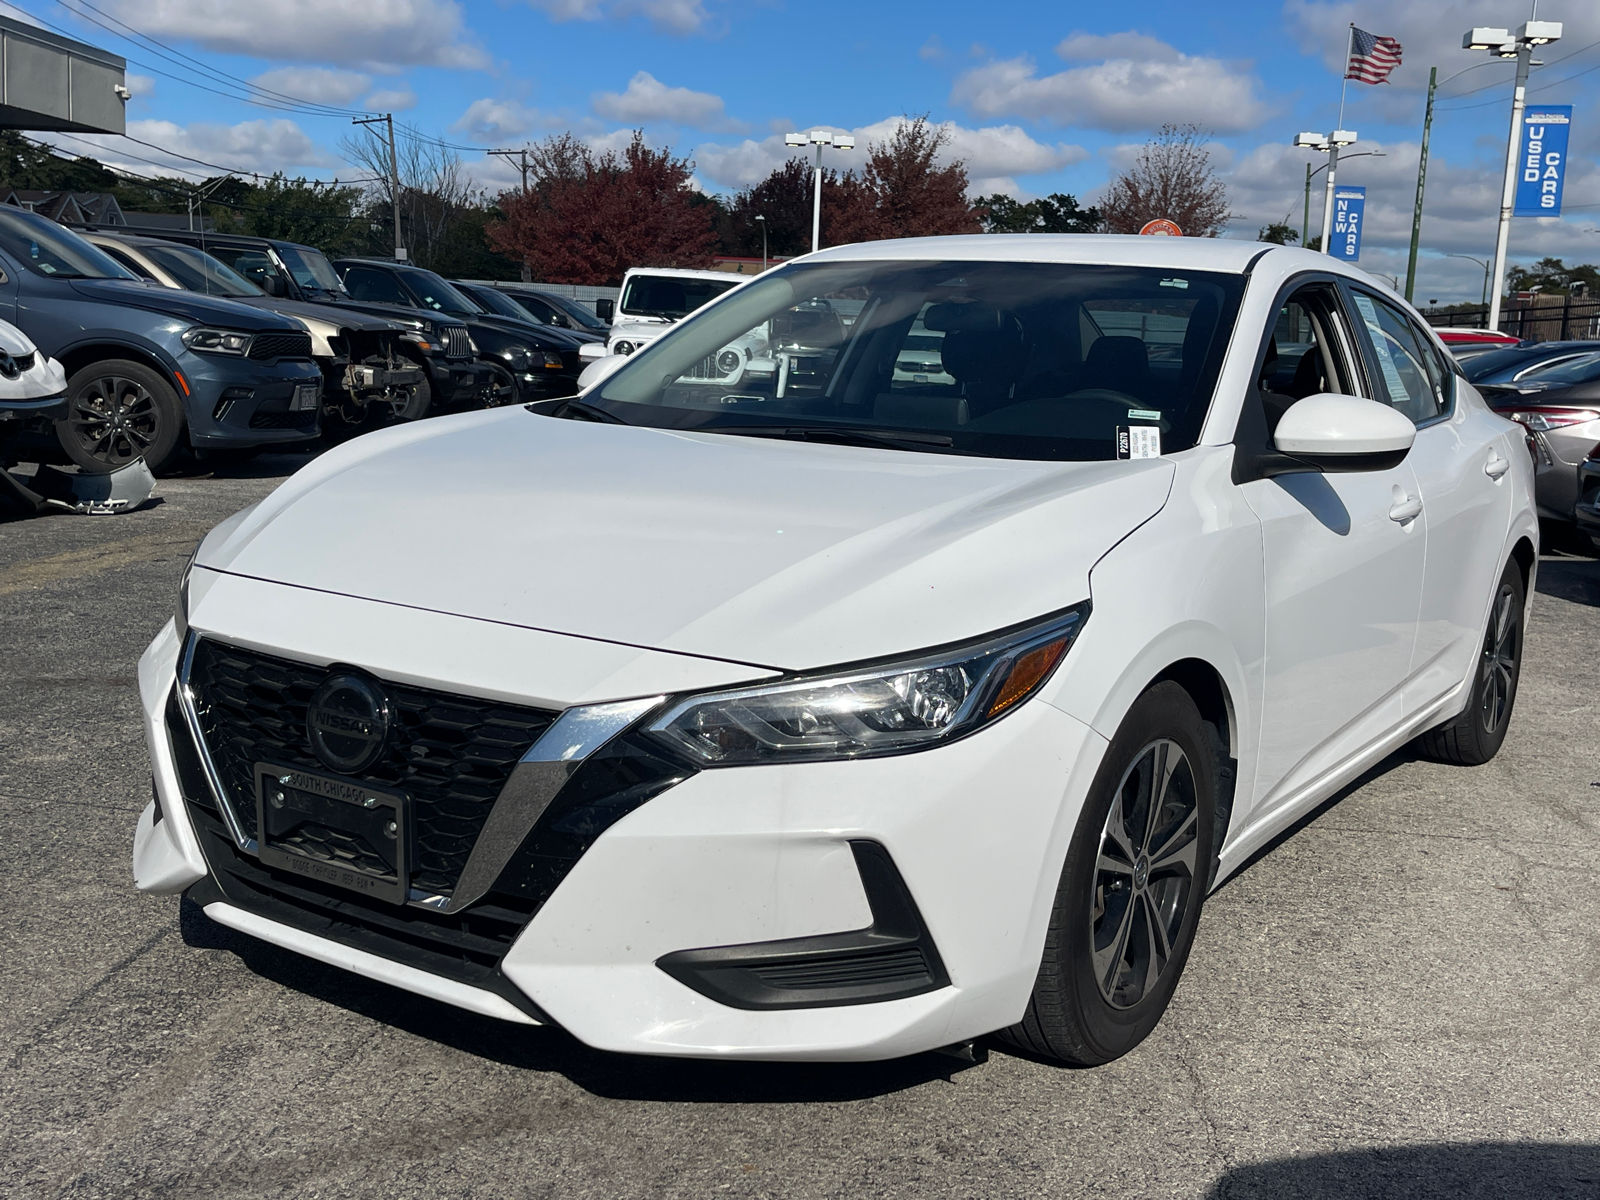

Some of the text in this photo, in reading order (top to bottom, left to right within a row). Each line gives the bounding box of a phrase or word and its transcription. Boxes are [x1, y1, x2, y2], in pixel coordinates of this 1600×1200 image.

[1524, 126, 1560, 208] USED CARS
[1335, 200, 1348, 233] NEW
[1345, 213, 1358, 256] CARS
[315, 710, 374, 736] NISSAN
[291, 772, 366, 803] SOUTH CHICAGO
